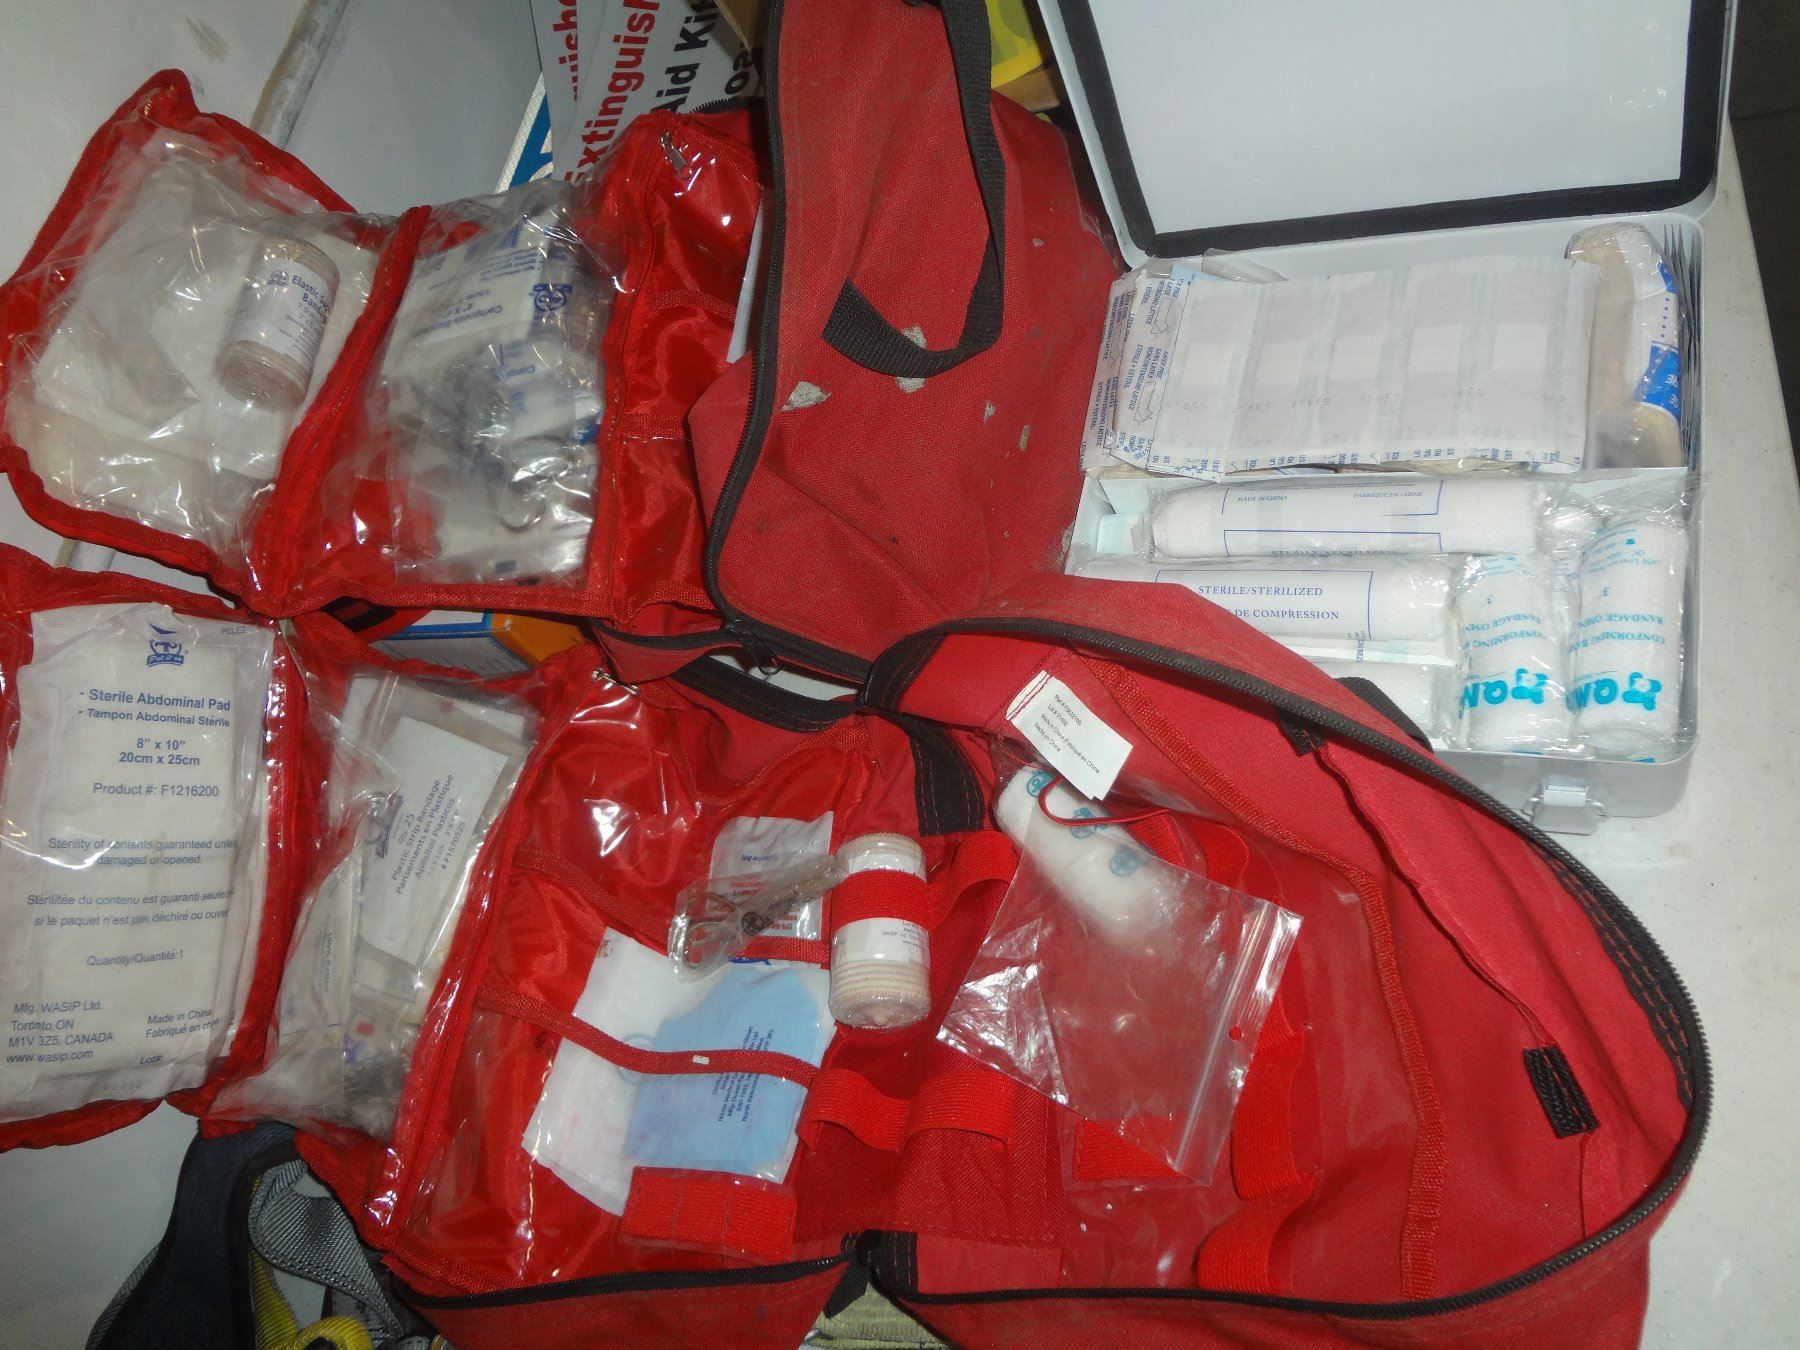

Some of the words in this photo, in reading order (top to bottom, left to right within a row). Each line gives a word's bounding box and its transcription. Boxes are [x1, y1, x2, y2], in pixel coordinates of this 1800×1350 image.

[292, 275, 320, 299] Elastic
[1198, 585, 1323, 597] STERILE/STERILIZED
[1234, 609, 1251, 618] DE
[1252, 609, 1340, 621] COMPRESSION
[88, 689, 133, 704] Sterile
[137, 692, 205, 709] Abdominal
[208, 699, 231, 711] Pad
[87, 708, 133, 721] Tampon
[136, 712, 195, 725] Abdominal
[154, 742, 161, 750] x
[119, 752, 153, 764] 20cm
[157, 756, 164, 764] x
[168, 754, 200, 766] 25cm
[1087, 760, 1100, 774] China
[93, 782, 142, 796] Product
[160, 784, 219, 797] F1216200
[405, 813, 414, 826] 25
[48, 837, 89, 851] Sterility
[93, 839, 107, 849] of
[155, 840, 212, 852] guaranteed
[97, 854, 147, 868] damaged
[79, 894, 93, 905] du
[96, 894, 140, 905] contenu
[142, 893, 158, 904] est
[160, 891, 200, 905] guaranti
[47, 915, 57, 926] le
[60, 915, 100, 928] paquet
[191, 910, 203, 921] ou
[147, 1013, 175, 1025] Made
[176, 1011, 186, 1021] in
[188, 1008, 213, 1019] China
[188, 1024, 201, 1033] en
[8, 1037, 34, 1048] M1V
[65, 1032, 114, 1045] CANADA
[6, 1050, 94, 1064] www.wasip.com
